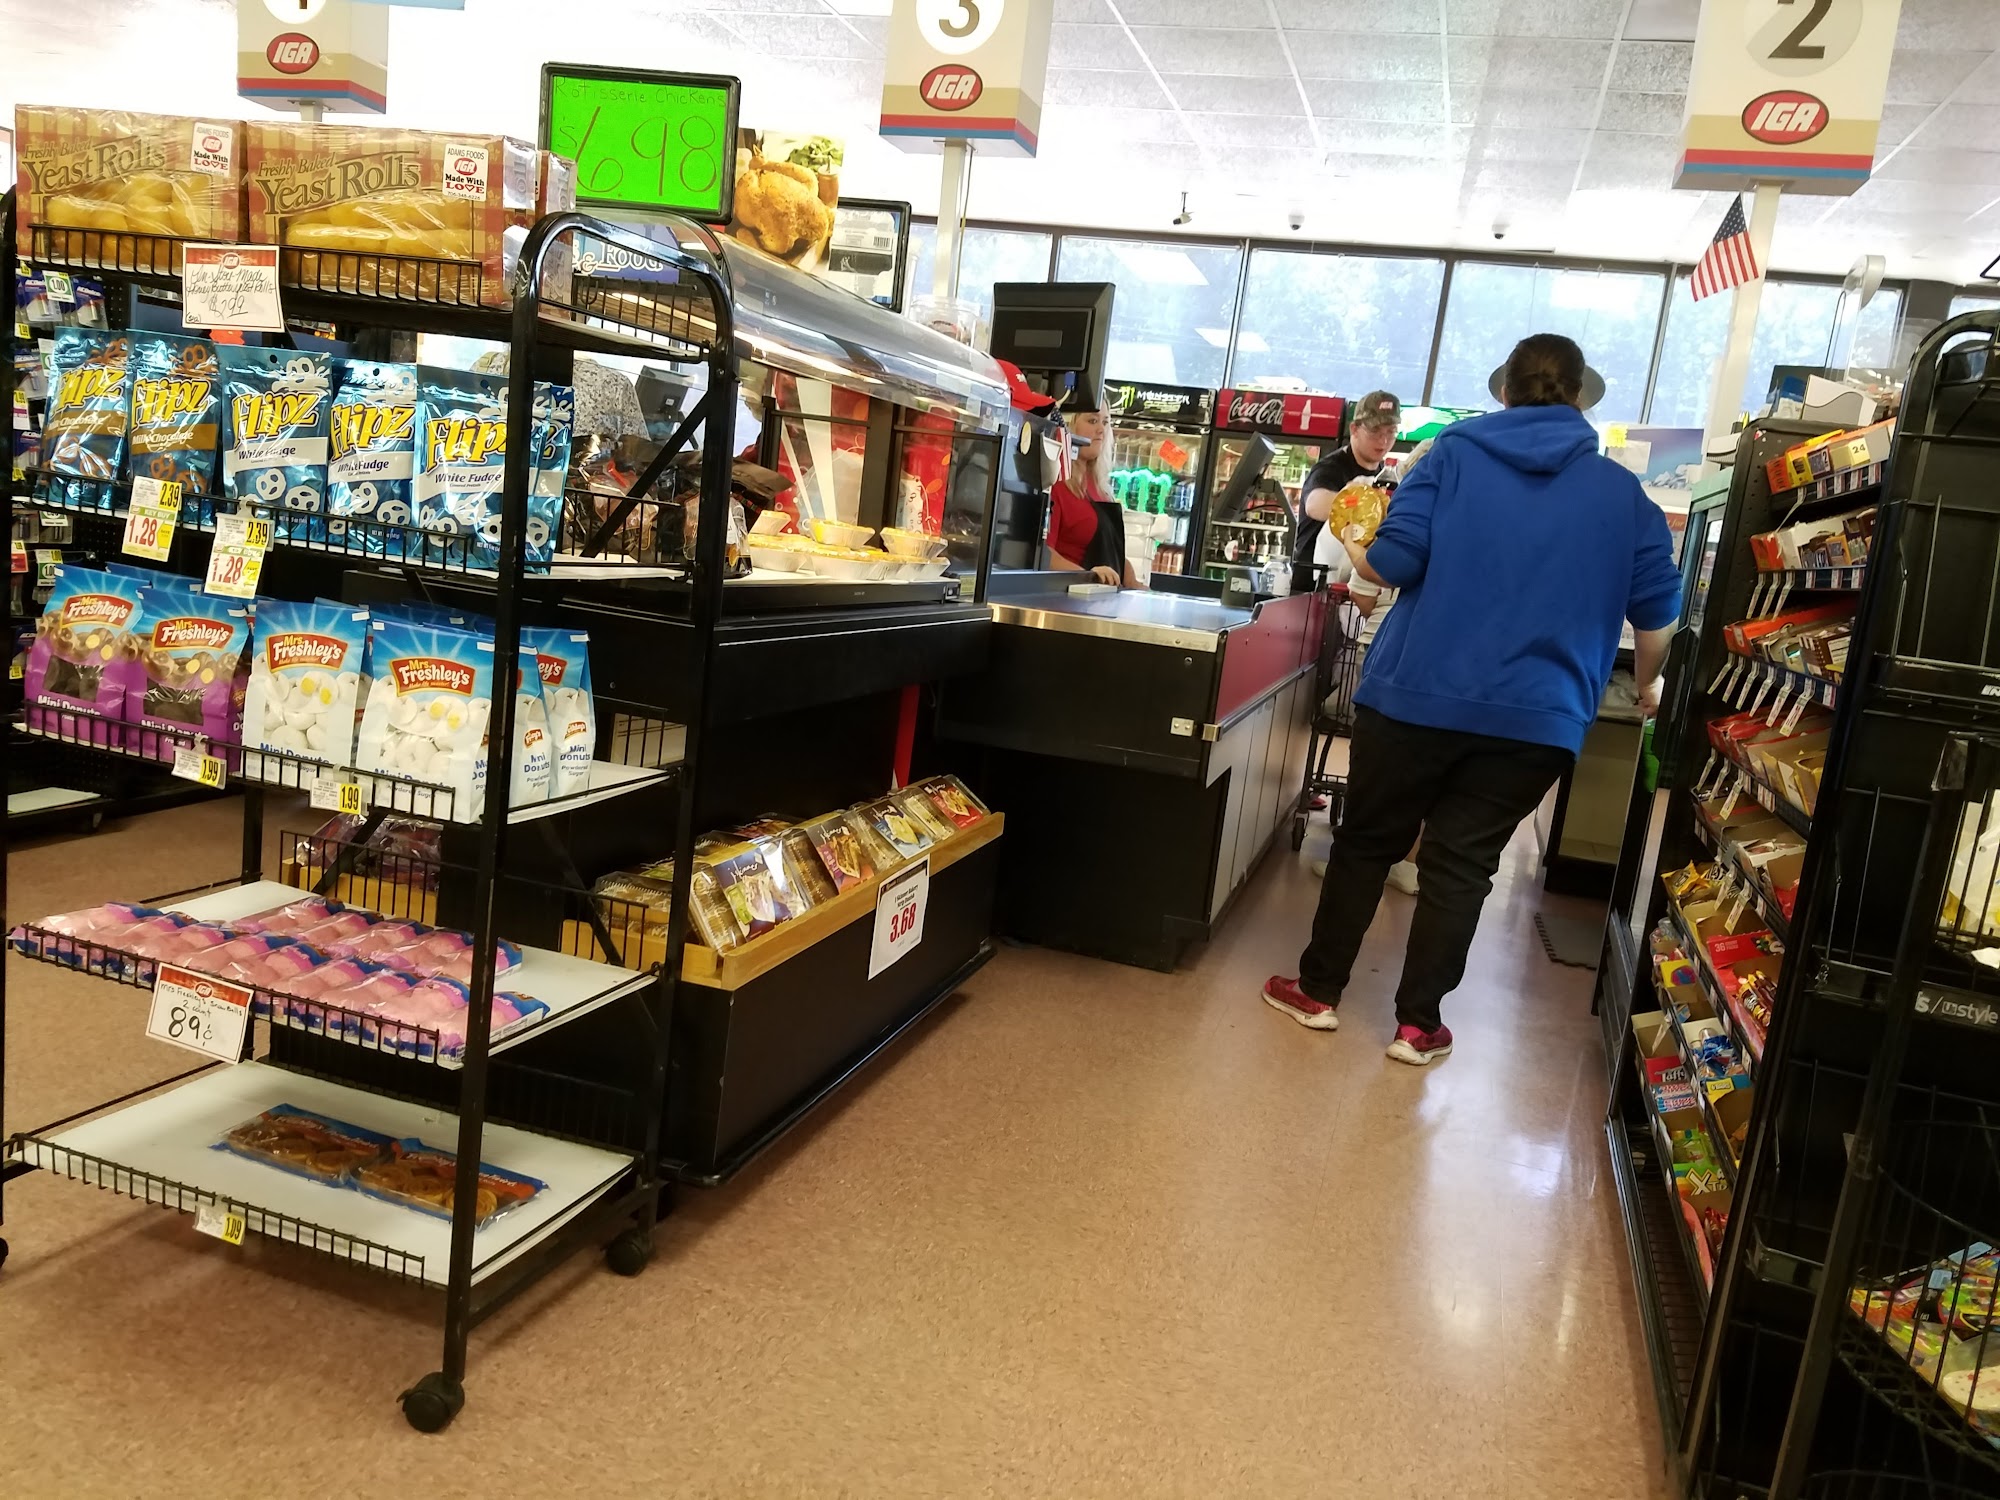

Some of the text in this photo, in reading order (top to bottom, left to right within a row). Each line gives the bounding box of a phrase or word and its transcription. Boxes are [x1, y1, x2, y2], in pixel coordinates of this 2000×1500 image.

[939, 0, 979, 38] 3
[1767, 0, 1833, 59] 2
[272, 41, 314, 64] IGA
[555, 77, 727, 108] Rotisserie Chickens
[927, 74, 976, 101] IGA
[1750, 101, 1819, 133] IGA
[22, 138, 166, 195] Yeast Rolls
[193, 150, 229, 163] Made With
[257, 152, 337, 180] Freshly Baked
[447, 147, 485, 160] ADAMS FOODS
[455, 159, 476, 173] IGA
[255, 155, 420, 215] Yeast Rolls
[445, 173, 485, 187] Made With
[130, 378, 211, 430] Flipz
[231, 392, 320, 451] Flipz
[331, 403, 416, 462] Flipz
[426, 418, 508, 473] Flip
[1852, 443, 1867, 454] 24
[359, 458, 390, 471] Fudge
[435, 472, 502, 485] White Fudge
[159, 482, 181, 508] 2.39
[128, 514, 158, 547] 1.28
[246, 521, 268, 546] 2.39
[212, 553, 244, 585] 1.28
[66, 601, 129, 623] Freshley's
[160, 620, 230, 646] Mrs. Freshley's
[272, 635, 343, 664] Mrs. Freshley's
[398, 660, 471, 690] Mrs. Freshley's
[201, 759, 219, 782] 1.99
[559, 753, 591, 762] Donuts
[341, 785, 360, 811] 1.99
[889, 902, 917, 943] 3.68
[1714, 942, 1726, 953] 36
[225, 1216, 243, 1240] 1.09
